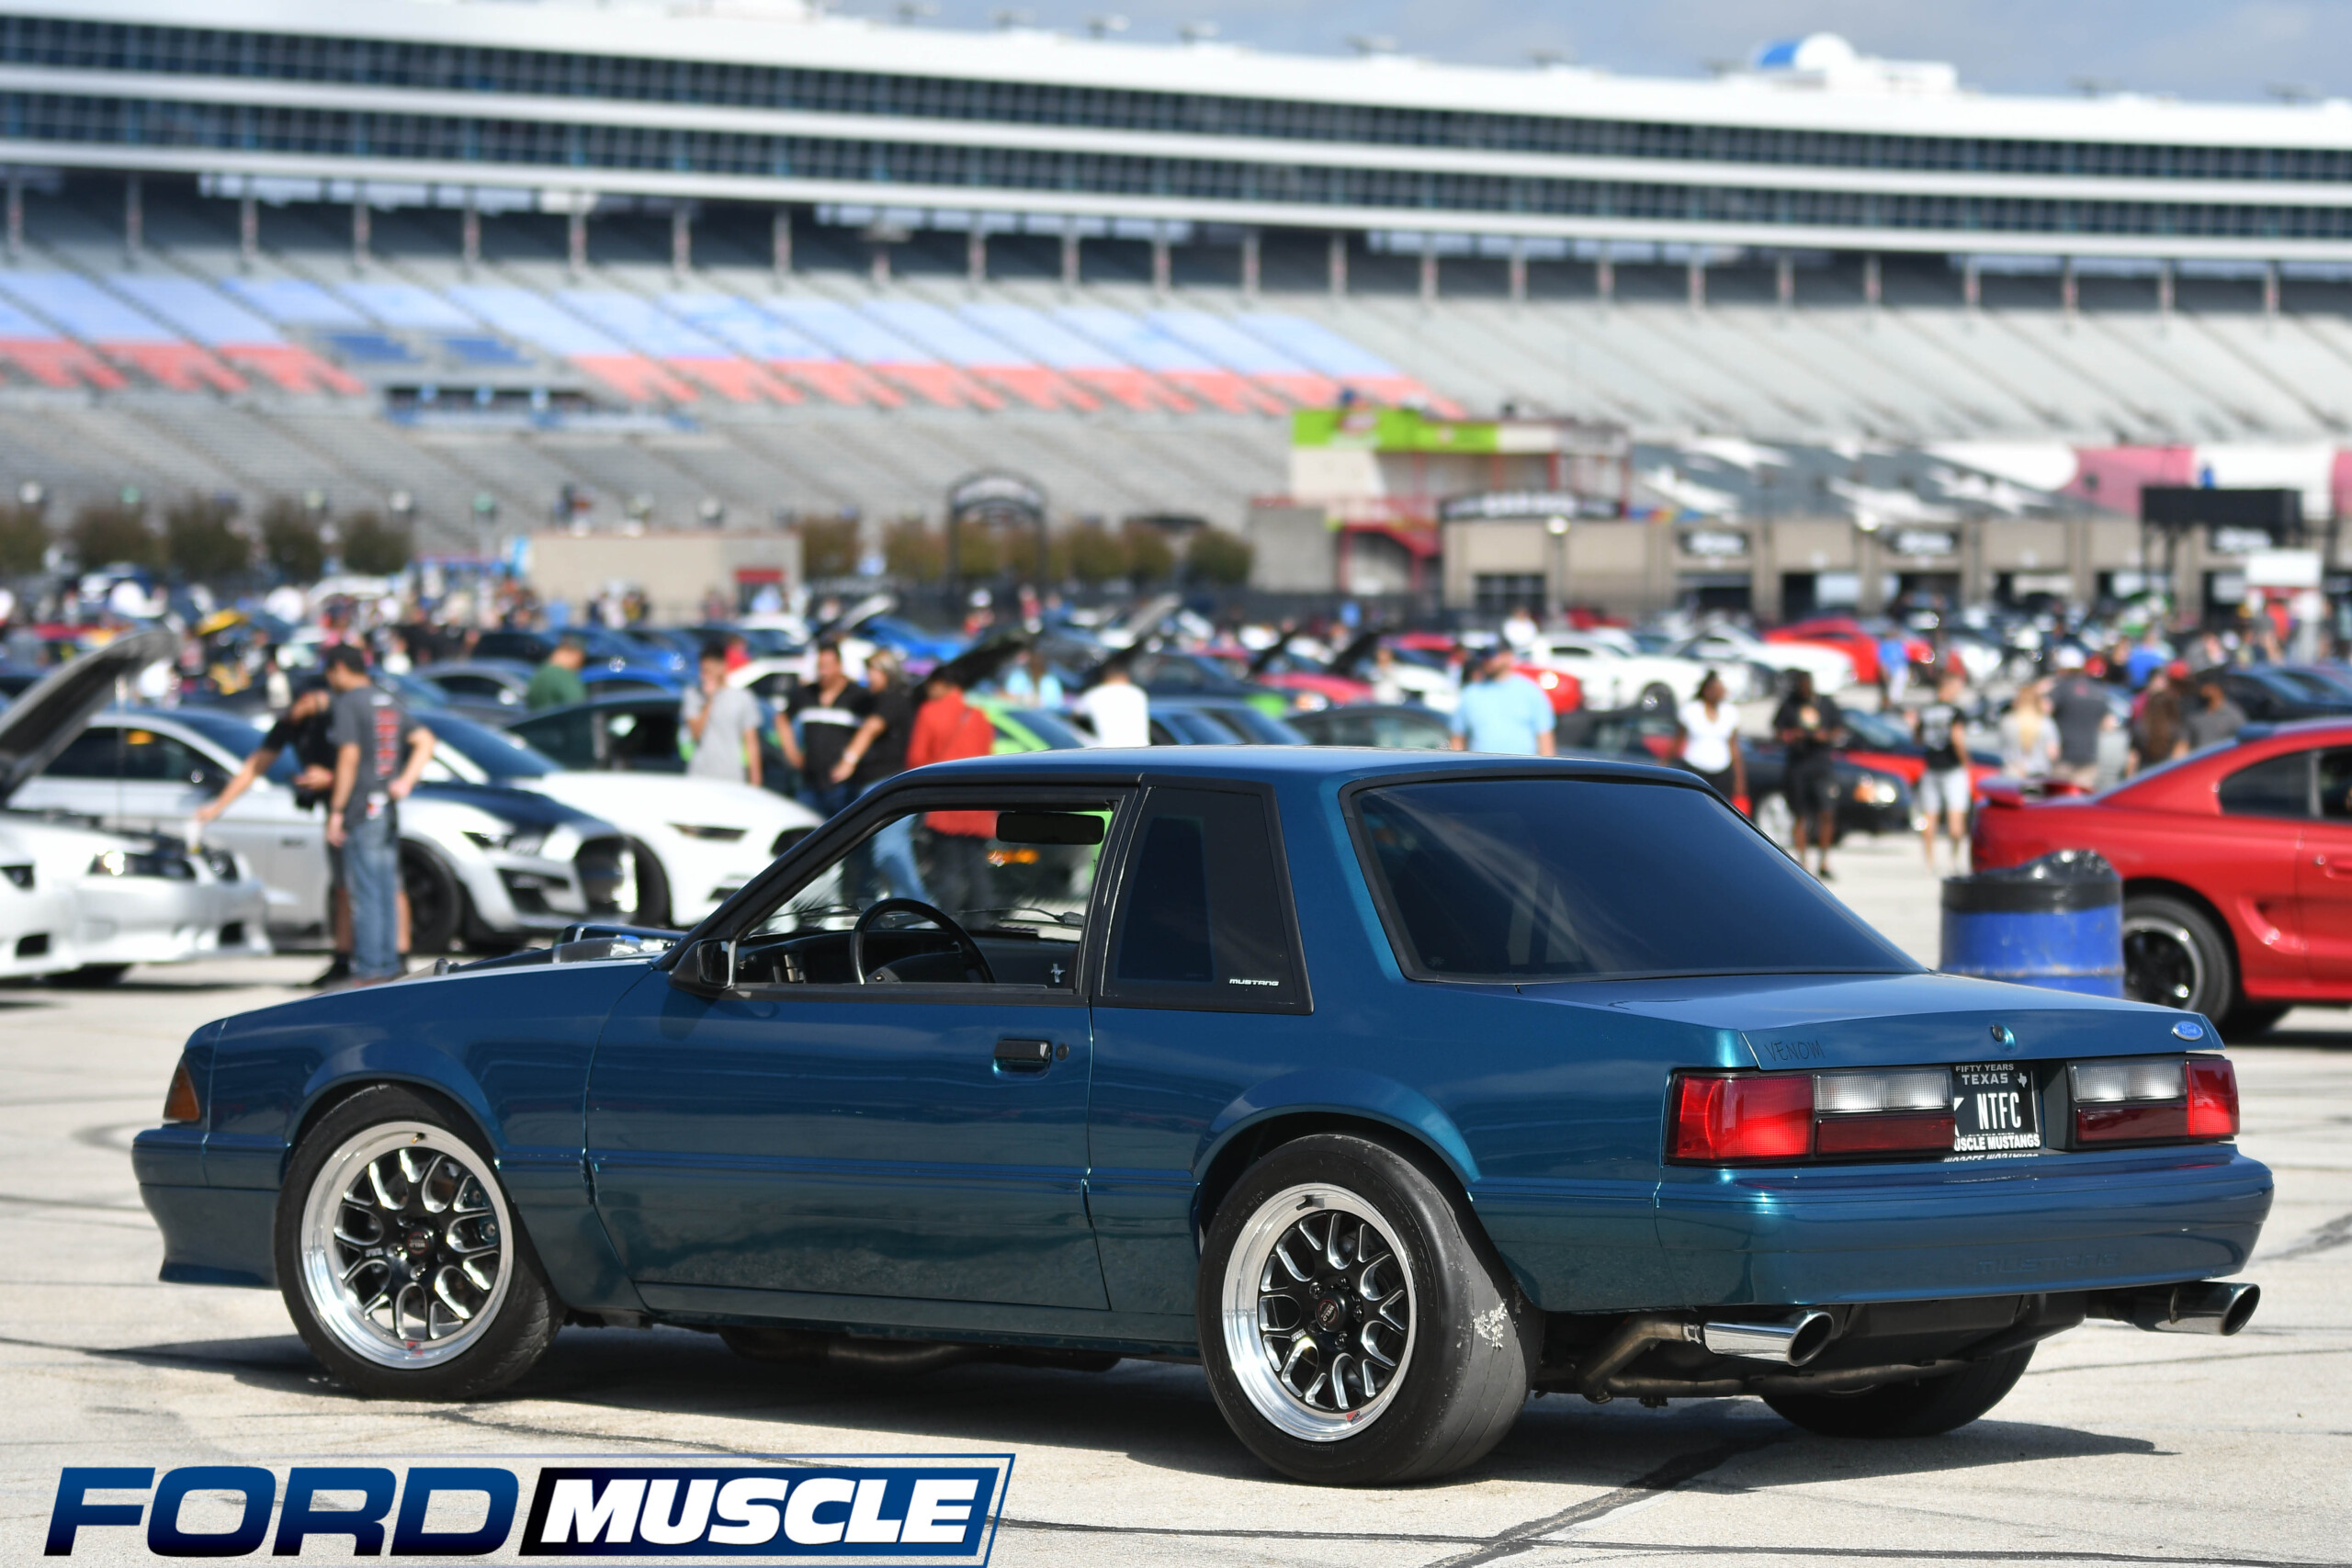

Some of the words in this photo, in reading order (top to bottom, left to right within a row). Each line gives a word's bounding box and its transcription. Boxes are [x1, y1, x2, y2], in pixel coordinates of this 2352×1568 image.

[1228, 978, 1280, 987] MUSTANG
[1764, 1040, 1826, 1062] VENOM
[1962, 1073, 2009, 1085] TEXAS
[1976, 1092, 2022, 1130] NTFC
[1953, 1136, 1986, 1152] USCLE
[1988, 1134, 2041, 1150] MUSTANGS
[1973, 1252, 2120, 1275] MUSTANG
